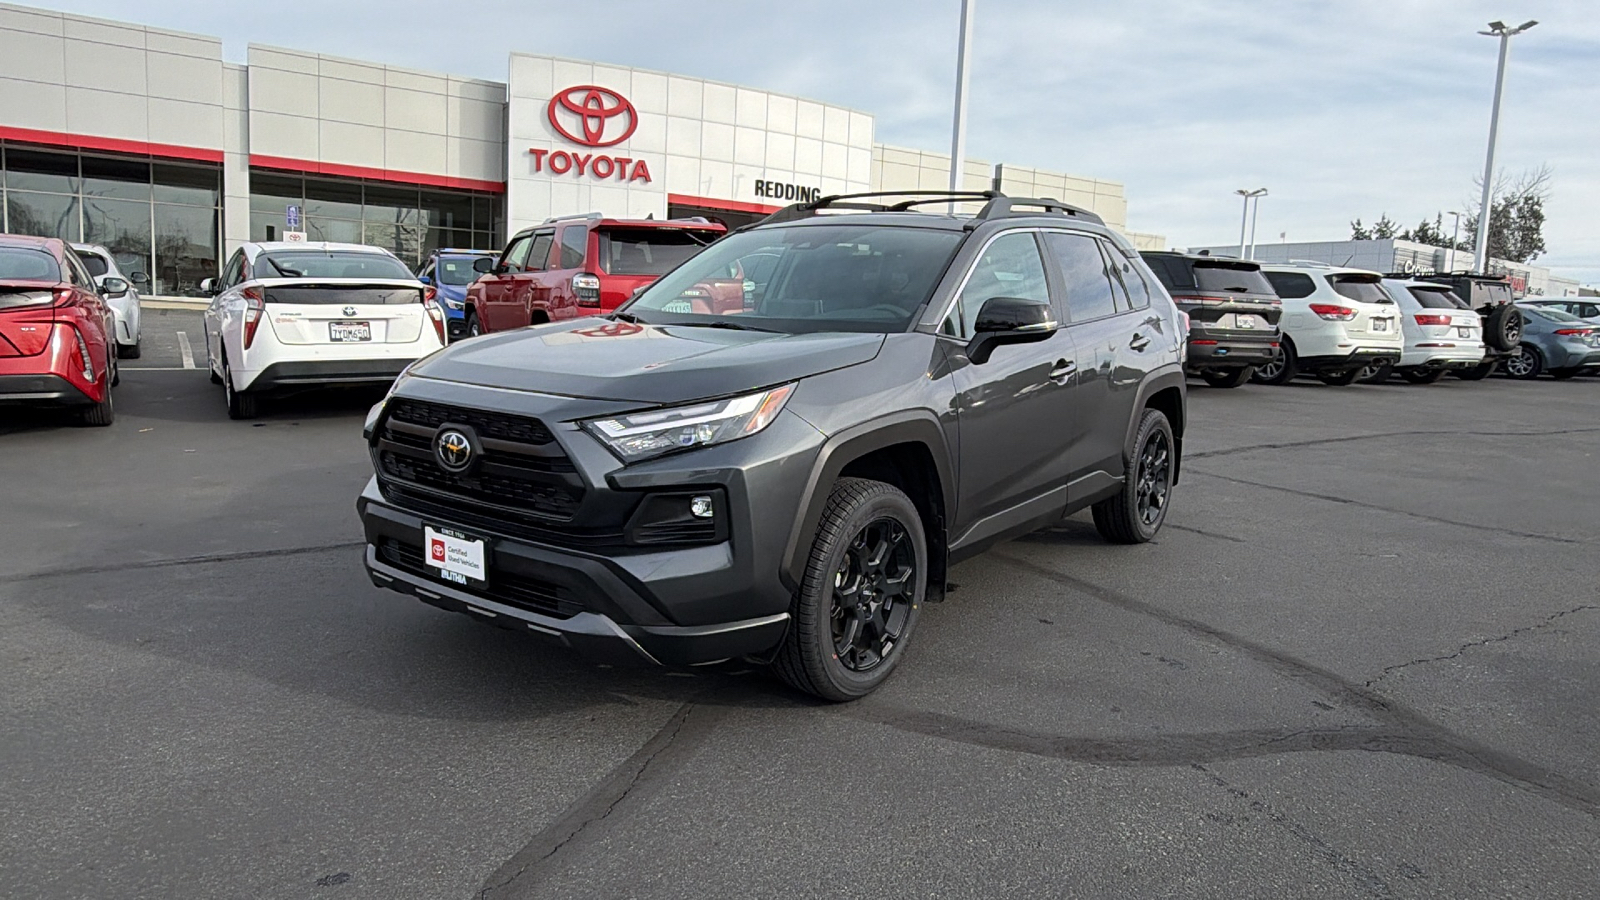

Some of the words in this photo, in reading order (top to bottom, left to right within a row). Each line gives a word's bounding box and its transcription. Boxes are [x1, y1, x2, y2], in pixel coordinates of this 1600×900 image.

[529, 148, 652, 182] TOYOTA
[754, 179, 821, 203] REDDING
[448, 546, 467, 557] Certified
[448, 555, 460, 563] Used
